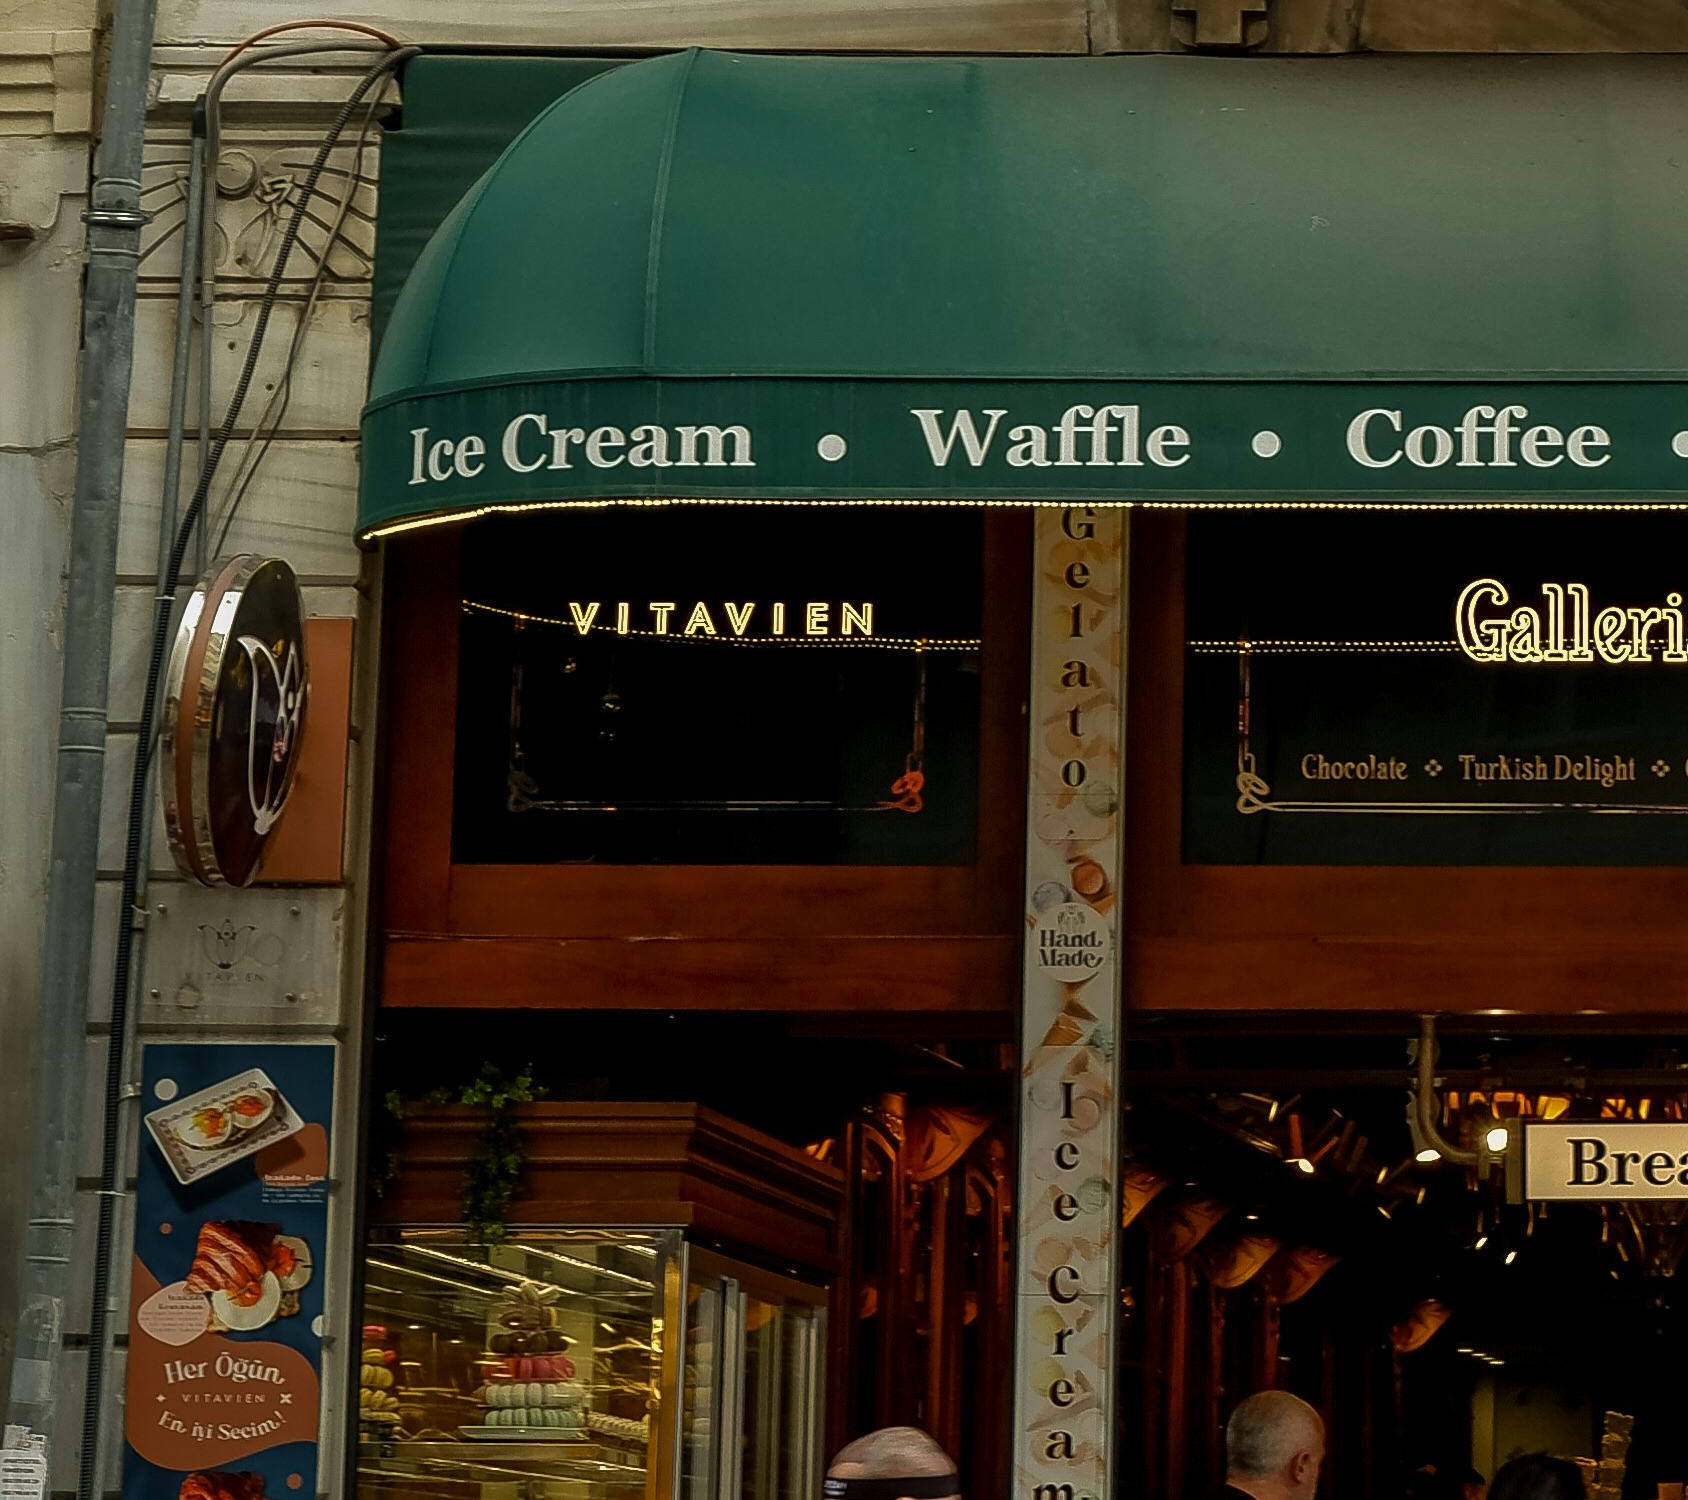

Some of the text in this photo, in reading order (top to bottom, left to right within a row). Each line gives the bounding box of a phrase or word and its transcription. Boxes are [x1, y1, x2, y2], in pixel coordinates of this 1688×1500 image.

[408, 426, 485, 485] Ice
[502, 413, 756, 473] Cream
[911, 405, 1192, 468] Waffle
[1345, 404, 1612, 470] Coffee
[569, 602, 874, 636] VITAVIEN
[1060, 507, 1096, 788] Gelato
[1300, 754, 1408, 782] Chocolate
[1458, 754, 1547, 783] Turkish
[1552, 754, 1636, 787] Delight
[1039, 928, 1103, 948] Hand
[1038, 950, 1104, 968] Made
[1054, 1082, 1080, 1223] Ice
[163, 1360, 208, 1384] Her
[182, 1393, 265, 1404] VITAVIEN
[158, 1410, 187, 1433] En
